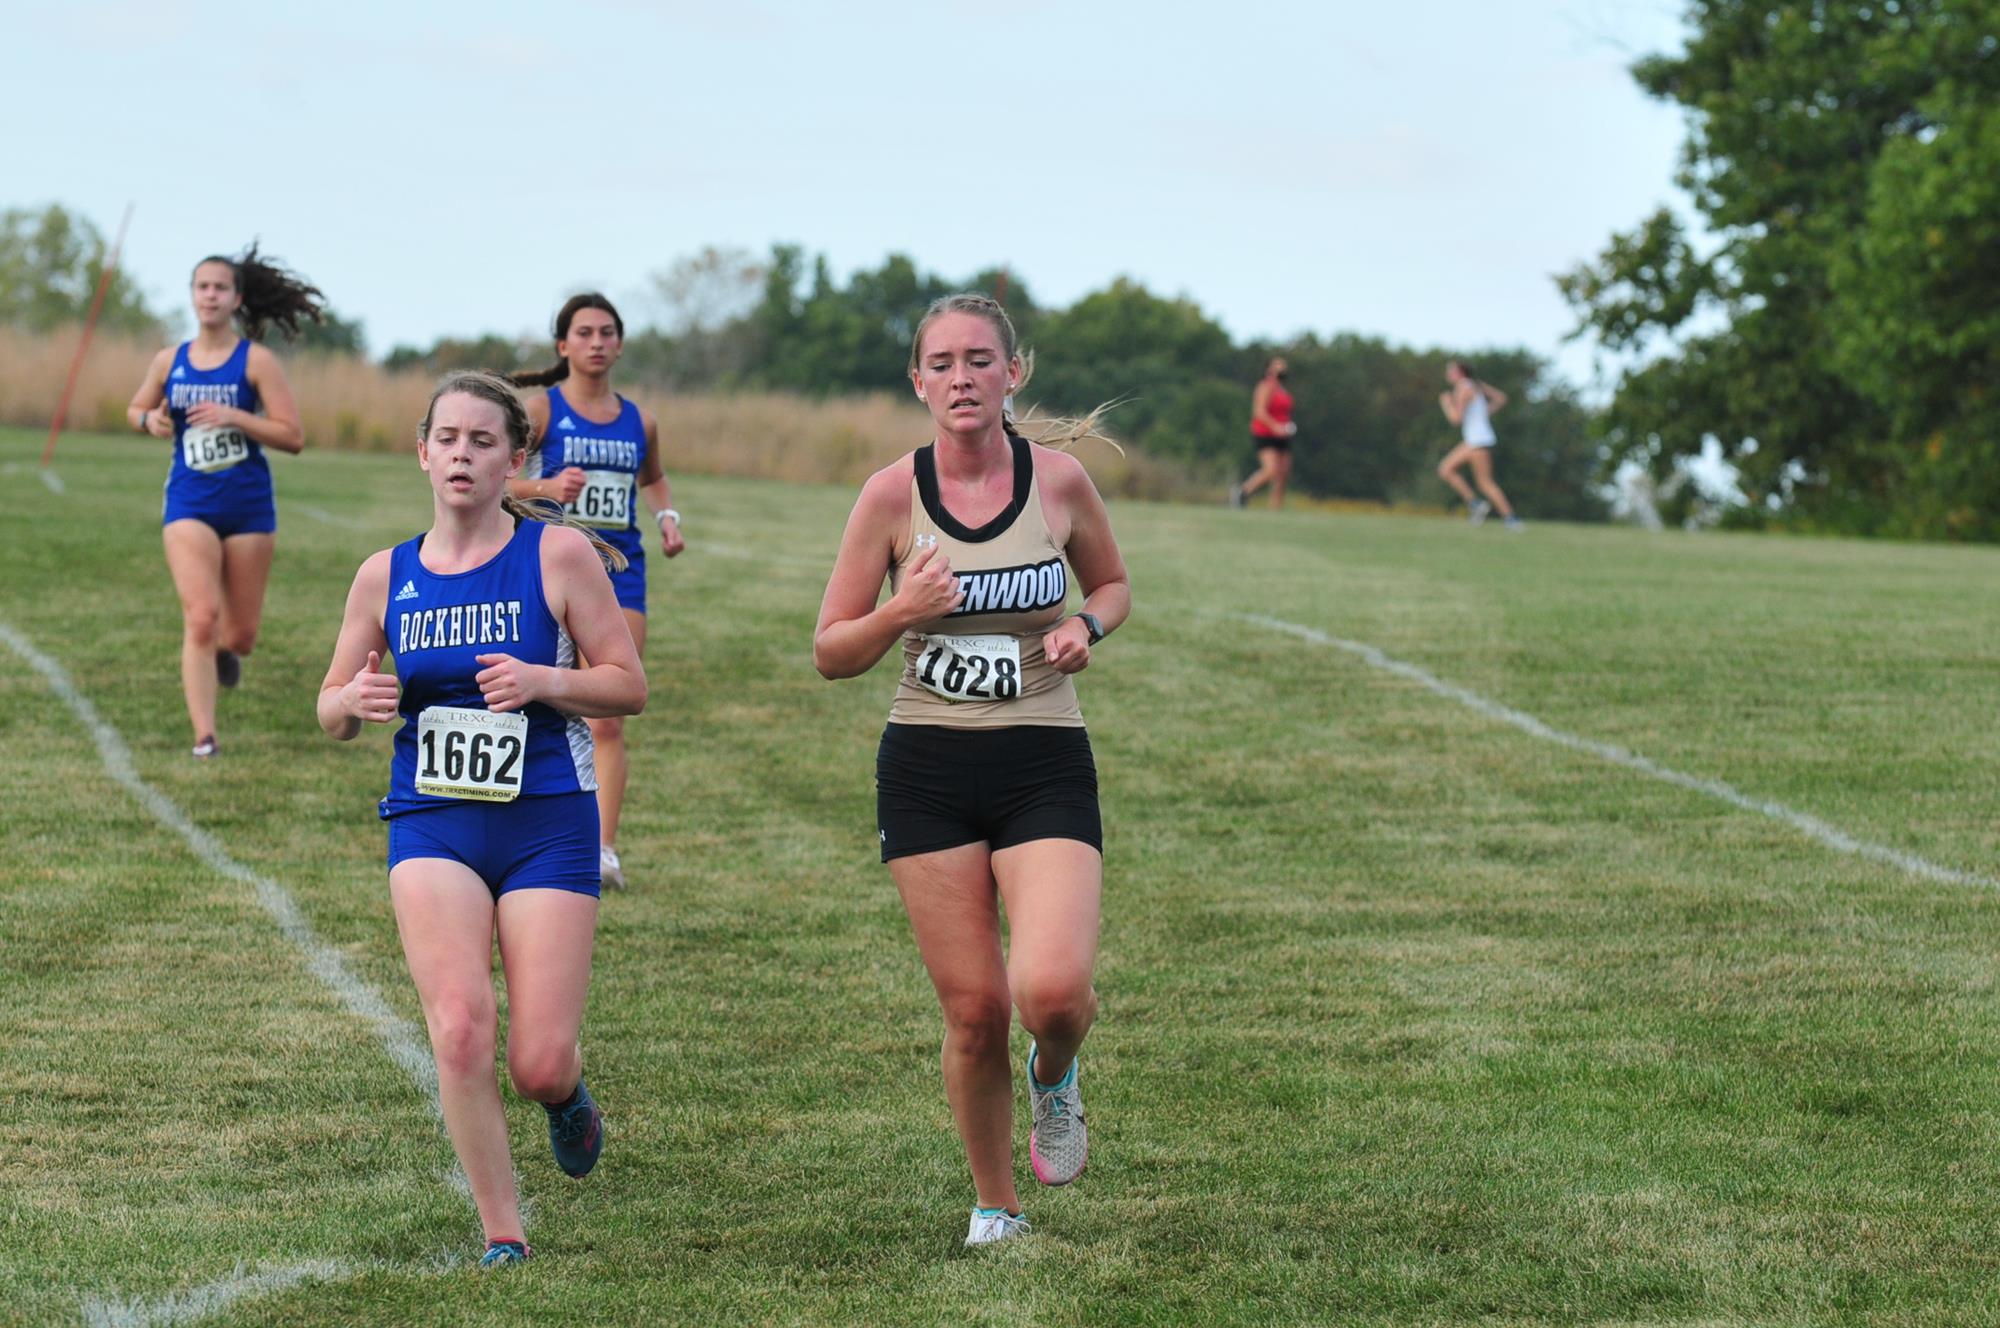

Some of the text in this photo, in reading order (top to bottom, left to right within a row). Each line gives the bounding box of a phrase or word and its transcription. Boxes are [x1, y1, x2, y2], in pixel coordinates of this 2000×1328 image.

[189, 432, 244, 465] 1659
[400, 601, 521, 654] ROCKHURST
[919, 646, 1018, 698] 1628
[447, 711, 494, 724] TRXC
[421, 729, 522, 785] 1662
